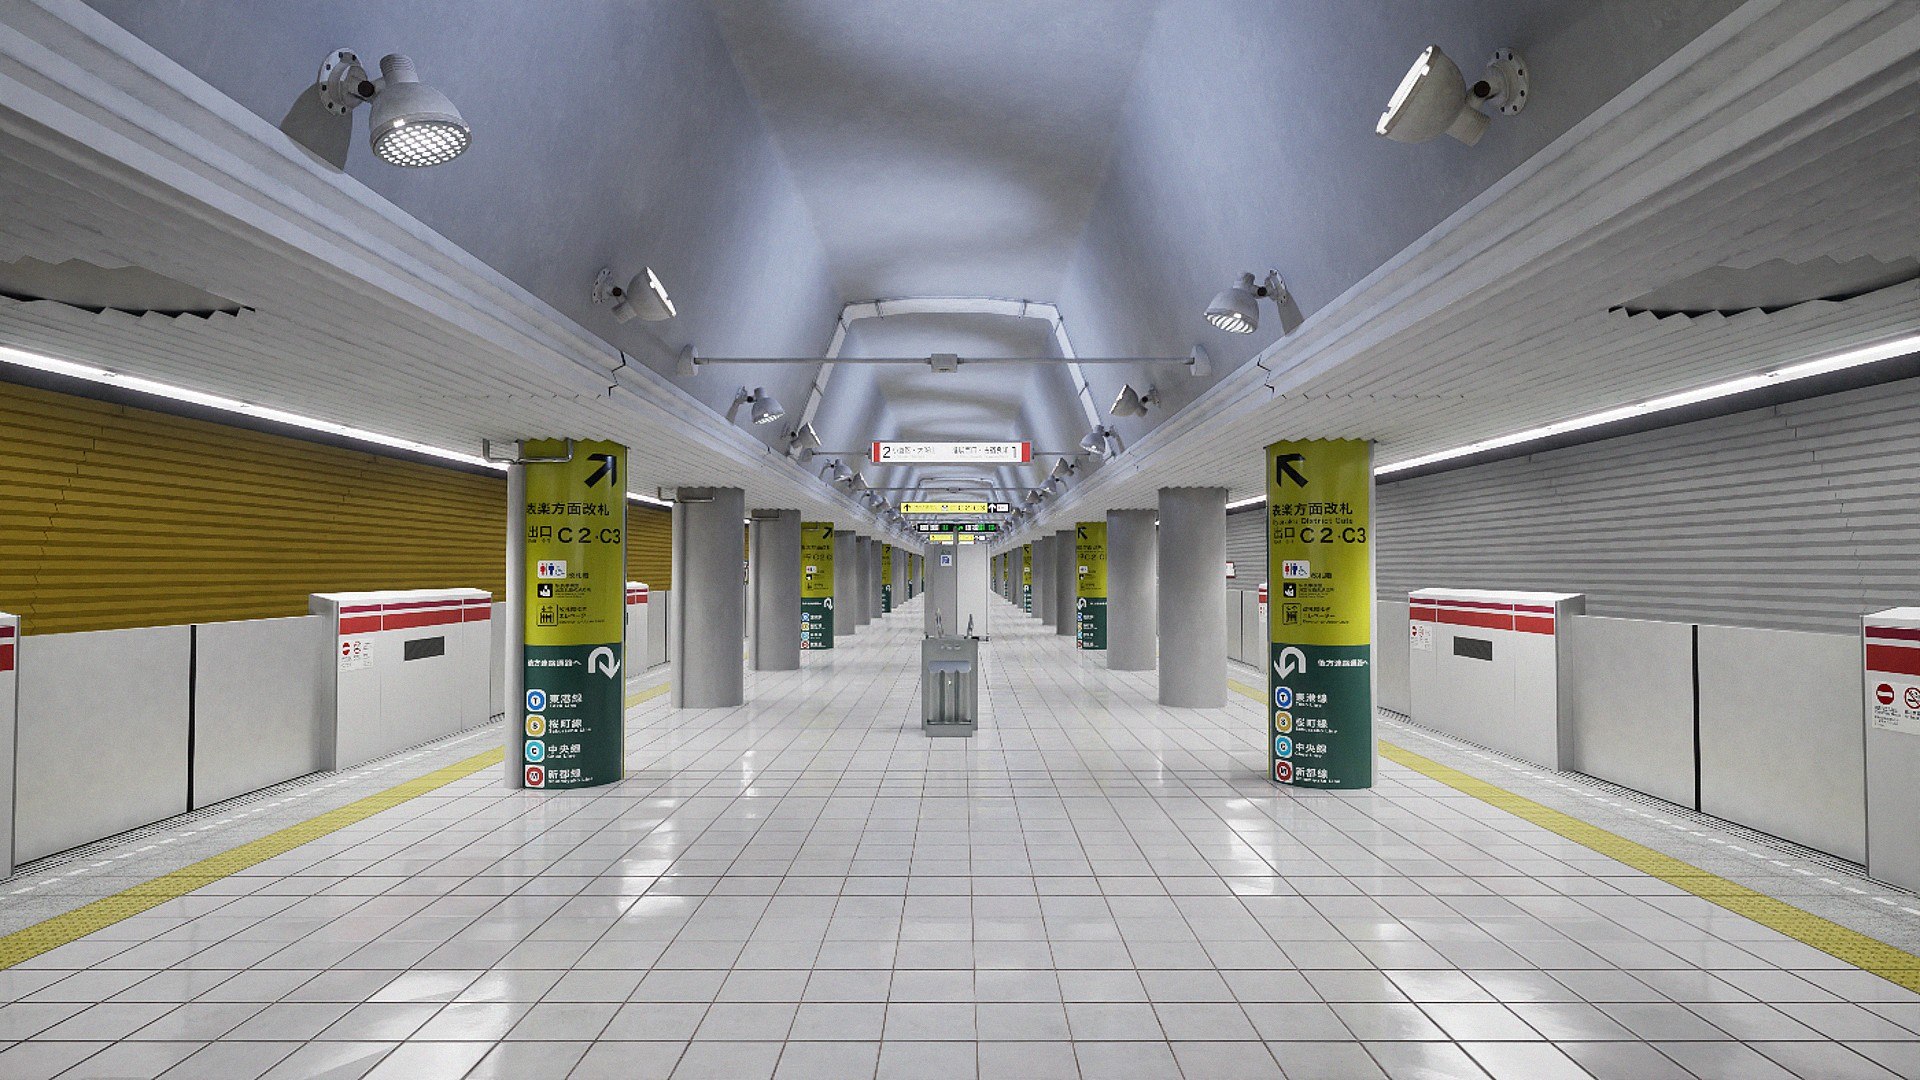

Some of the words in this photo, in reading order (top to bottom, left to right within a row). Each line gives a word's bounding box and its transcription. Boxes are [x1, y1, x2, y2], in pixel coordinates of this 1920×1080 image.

[883, 446, 891, 458] 2
[1011, 446, 1017, 458] 1
[528, 526, 552, 538] 出口
[1274, 527, 1295, 539] 出口
